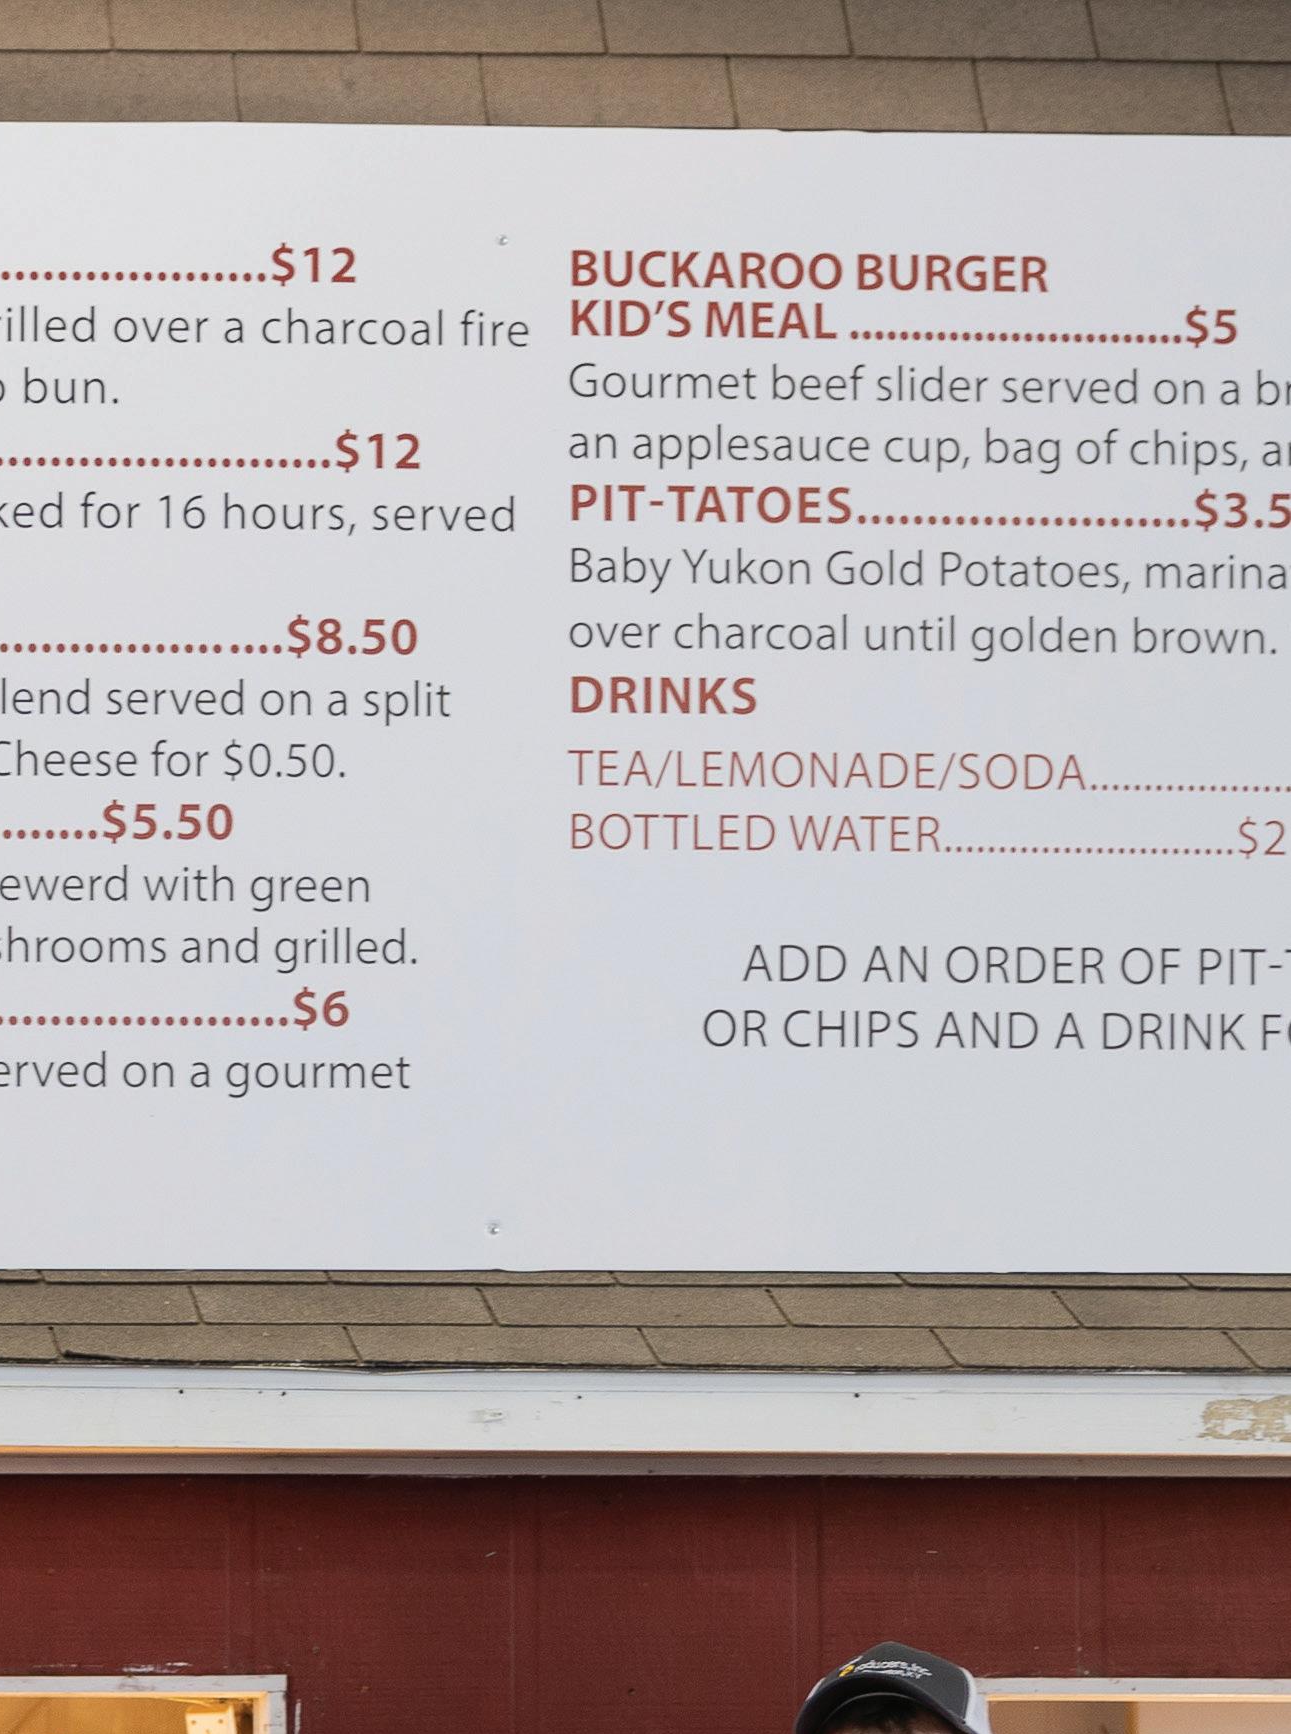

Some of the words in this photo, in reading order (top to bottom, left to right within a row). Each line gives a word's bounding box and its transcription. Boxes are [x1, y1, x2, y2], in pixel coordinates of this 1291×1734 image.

[270, 241, 357, 288] $12
[570, 248, 844, 291] BUCKAROO
[856, 252, 1050, 294] BURGER
[113, 316, 210, 344] over
[223, 317, 245, 344] a
[261, 306, 444, 347] charcoal
[459, 308, 530, 348] fire
[569, 298, 692, 339] KID'S
[705, 300, 839, 341] MEAL
[1184, 304, 1239, 350] $5
[23, 366, 120, 405] bun.
[568, 362, 758, 401] Gourmet
[771, 362, 867, 402] beef
[875, 364, 989, 403] slider
[1001, 367, 1139, 405] served
[1152, 378, 1205, 406] on
[1219, 379, 1241, 407] a
[334, 428, 421, 474] $12
[568, 432, 618, 460] an
[632, 423, 871, 471] applesauce
[883, 436, 971, 474] cup,
[984, 426, 1062, 475] bag
[1075, 427, 1120, 466] of
[1129, 428, 1249, 476] chips,
[79, 490, 141, 530] for
[158, 494, 207, 530] 16
[223, 491, 357, 537] hours,
[371, 494, 516, 533] served
[570, 483, 853, 525] PIT-TATOES
[570, 545, 673, 595] Baby
[681, 546, 811, 586] Yukon
[825, 548, 924, 587] Gold
[939, 551, 1131, 595] Potatoes,
[1145, 554, 1291, 591] marina
[286, 613, 419, 660] $8.50
[568, 621, 662, 649] over
[673, 611, 848, 651] charcoal
[864, 614, 956, 652] until
[970, 615, 1117, 663] golden
[1133, 616, 1277, 655] brown.
[105, 677, 245, 717] served
[259, 689, 313, 717] on
[326, 689, 349, 717] a
[363, 679, 452, 727] split
[570, 675, 758, 716] DRINKS
[150, 738, 210, 778] for
[223, 738, 346, 782] $0.50.
[101, 798, 234, 845] $5.50
[570, 812, 776, 852] BOTTLED
[788, 814, 941, 853] WATER
[1238, 815, 1287, 860] $2
[142, 864, 235, 903] with
[249, 875, 370, 913] green
[180, 925, 259, 964] and
[273, 926, 418, 975] grilled.
[742, 944, 848, 983] ADD
[862, 944, 928, 984] AN
[944, 945, 1105, 985] ORDER
[1119, 946, 1182, 986] OF
[1198, 947, 1291, 987] PIT-
[292, 985, 351, 1032] $6
[702, 1008, 768, 1048] OR
[782, 1009, 920, 1049] CHIPS
[934, 1010, 1039, 1050] AND
[1053, 1011, 1086, 1050] A
[1101, 1012, 1247, 1051] DRINK
[122, 1061, 175, 1089] on
[189, 1061, 211, 1089] a
[225, 1056, 411, 1099] gourmet
